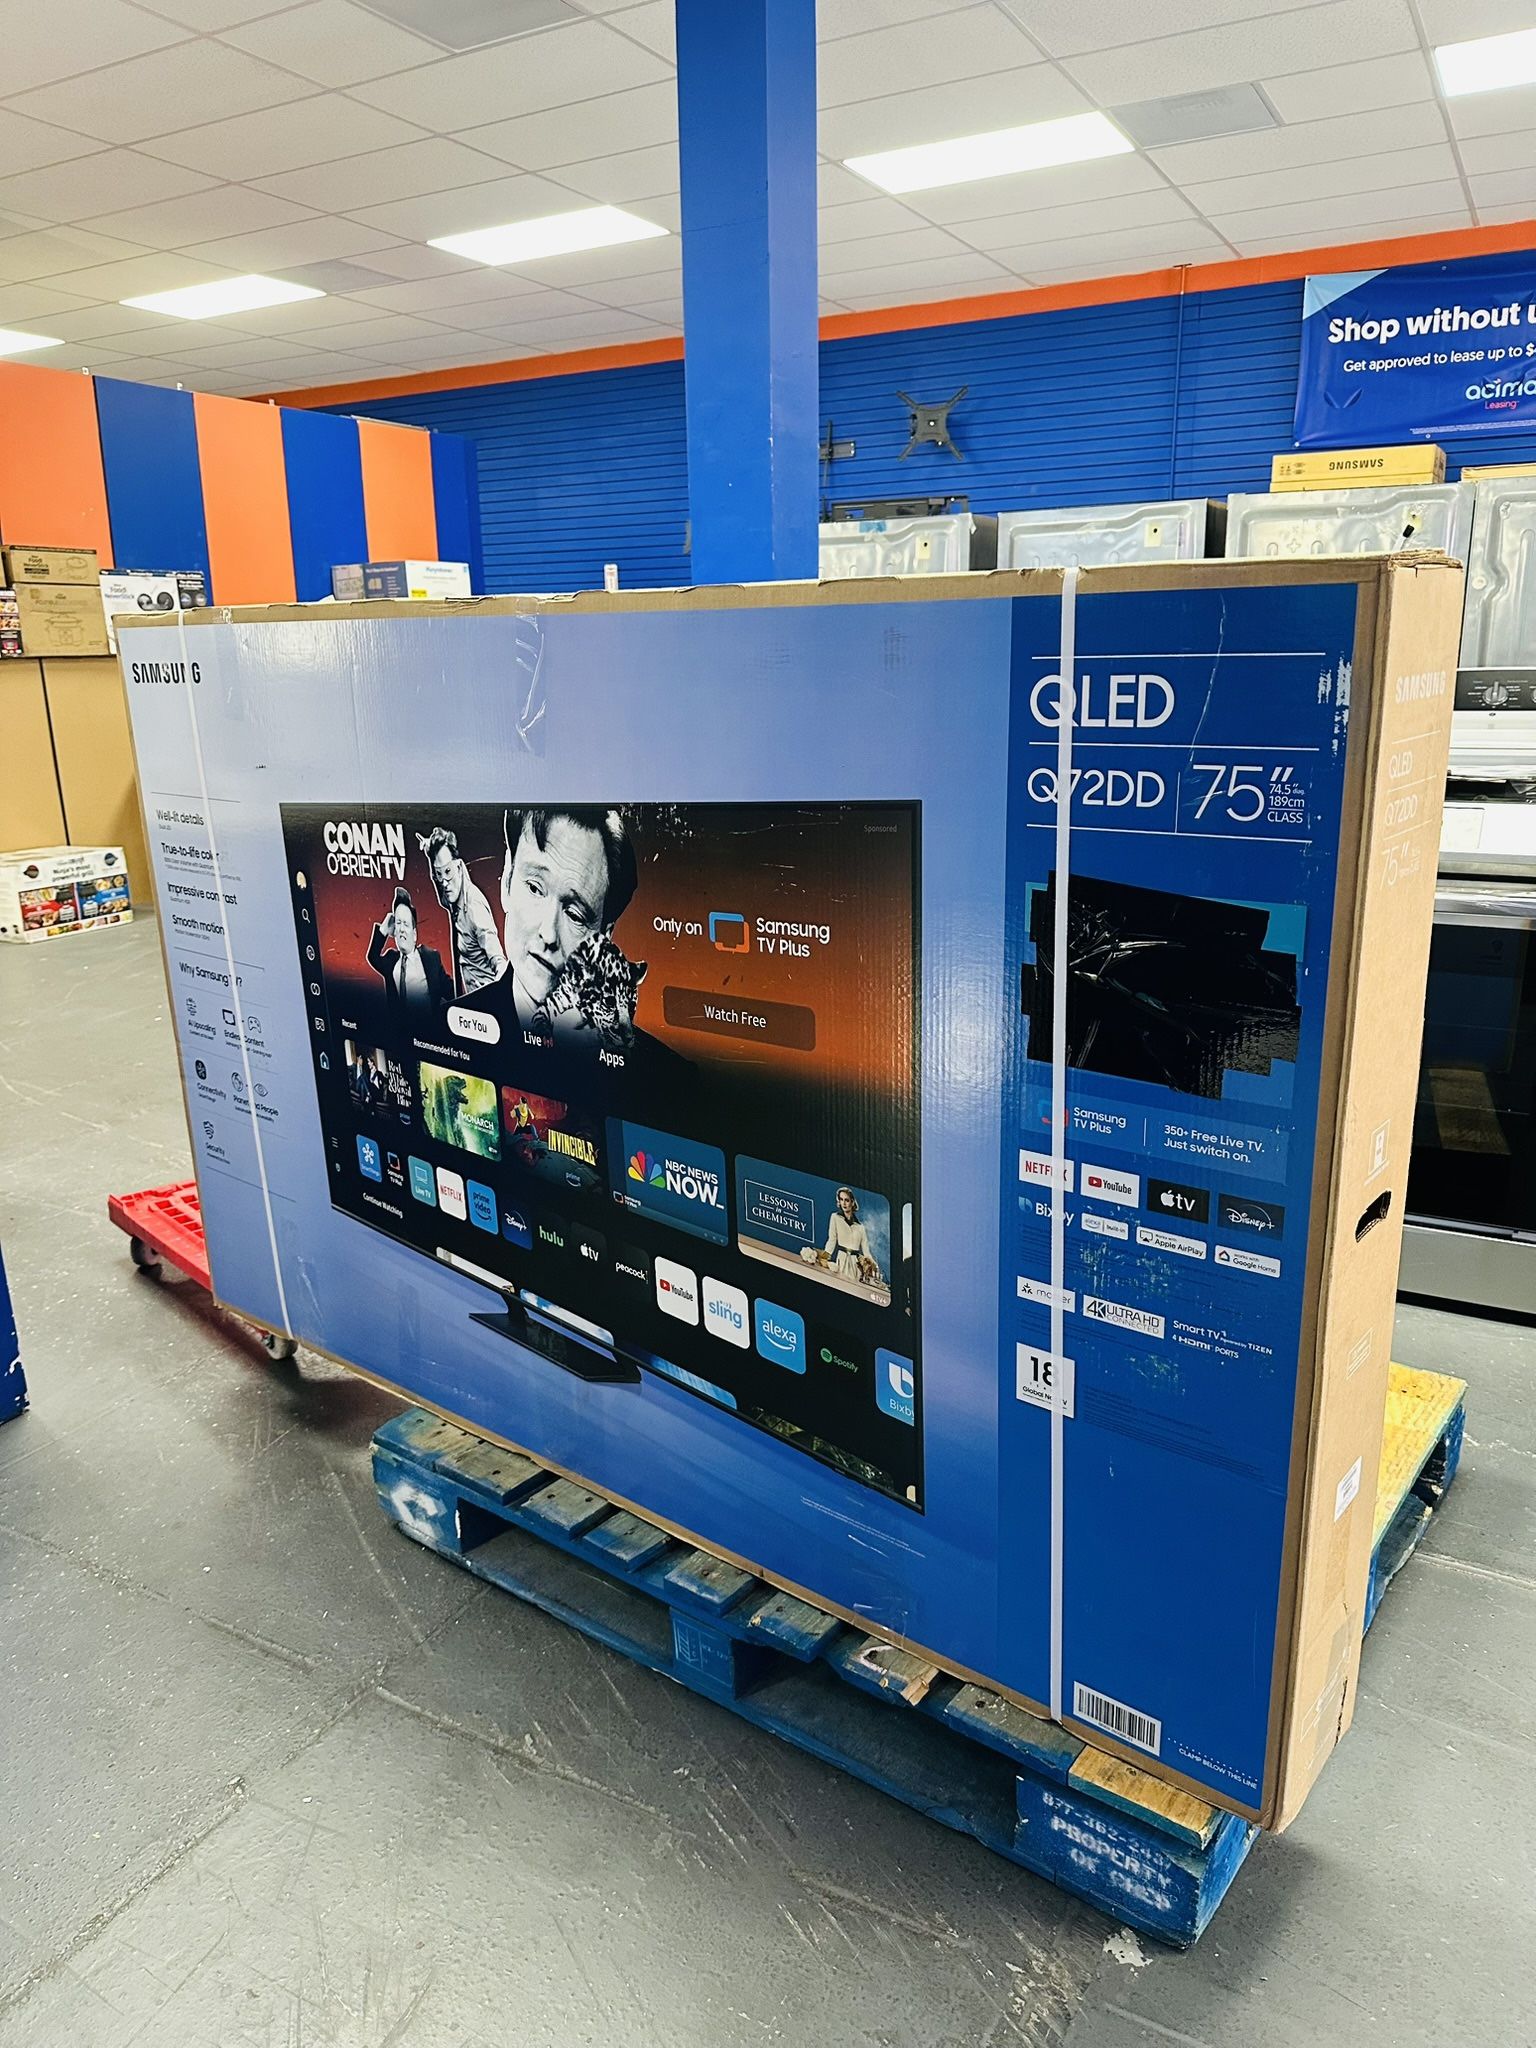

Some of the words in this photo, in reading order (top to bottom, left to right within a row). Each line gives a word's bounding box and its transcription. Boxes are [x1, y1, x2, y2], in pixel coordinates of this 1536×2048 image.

[1328, 317, 1400, 344] Shop
[1406, 303, 1521, 335] without
[1343, 359, 1367, 372] Get
[1369, 353, 1431, 372] approved
[1434, 353, 1448, 364] to
[1451, 350, 1484, 363] lease
[1488, 349, 1505, 361] up
[1508, 346, 1523, 357] to
[1485, 401, 1517, 409] Leasing
[1328, 458, 1384, 470] SAMSUNG
[1395, 671, 1446, 704] SAMSUNG
[1029, 675, 1174, 727] QLED
[1389, 751, 1413, 778] QLED
[1027, 768, 1165, 807] Q72DD
[1269, 796, 1304, 807] 189cm
[1385, 793, 1418, 827] Q72DD
[156, 809, 180, 823] Well-lit
[180, 813, 204, 826] details
[1267, 811, 1303, 823] CLASS
[863, 824, 897, 833] Sponsored
[323, 821, 405, 857] CONAN
[161, 842, 200, 857] True-to-life
[201, 851, 219, 861] colr
[167, 882, 204, 898] Impressive
[206, 891, 237, 905] conast
[172, 914, 199, 929] Smooth
[200, 921, 225, 935] motion
[653, 917, 683, 937] Only
[685, 921, 702, 936] on
[756, 917, 830, 945] Samsung
[757, 937, 775, 954] TV
[780, 939, 810, 957] Plus
[179, 961, 194, 978] Why
[196, 966, 229, 986] Samsung
[341, 1018, 357, 1029] Recent
[458, 1015, 472, 1030] For
[474, 1018, 488, 1034] You
[703, 1004, 738, 1024] Watch
[741, 1011, 767, 1028] Free
[523, 1030, 542, 1047] Live
[413, 1038, 450, 1055] Recommended
[450, 1048, 458, 1057] for
[459, 1049, 470, 1061] You
[599, 1048, 625, 1068] Apps
[197, 1082, 226, 1100] Connectivity
[1073, 1118, 1088, 1131] TV
[1090, 1121, 1112, 1134] Plus
[1074, 1107, 1127, 1128] Samsung
[548, 1128, 597, 1167] INVINCIBLE
[1164, 1125, 1188, 1138] 350+
[1191, 1130, 1217, 1144] Free
[1220, 1135, 1244, 1149] Live
[1247, 1140, 1265, 1153] TV.
[205, 1142, 225, 1157] Security
[1164, 1137, 1188, 1151] Just
[1190, 1142, 1230, 1160] switch
[1232, 1150, 1251, 1164] on.
[665, 1159, 687, 1174] NBC
[687, 1166, 718, 1185] NEWS
[440, 1185, 462, 1202] NETFLIX
[473, 1191, 490, 1205] prime
[759, 1192, 799, 1212] LESSONS
[1025, 1160, 1067, 1181] NETFX
[1103, 1180, 1132, 1194] YouTube
[1176, 1191, 1195, 1212] tv
[1226, 1207, 1275, 1231] Disney+
[474, 1201, 491, 1215] video
[1035, 1202, 1074, 1226] Bixy
[752, 1206, 807, 1233] CHEMISTRY
[539, 1225, 564, 1248] hulu
[588, 1247, 599, 1261] tv
[1154, 1238, 1176, 1249] Apple
[1177, 1244, 1203, 1257] AirPlay
[615, 1261, 646, 1281] peacock
[1233, 1257, 1256, 1269] Google
[1257, 1264, 1276, 1273] Home
[671, 1284, 694, 1302] YouTube
[1037, 1289, 1071, 1304] maer
[708, 1299, 743, 1329] sling
[1087, 1300, 1106, 1318] 4K
[1106, 1303, 1141, 1322] ULTRA
[1143, 1314, 1160, 1328] HD
[1106, 1313, 1159, 1334] CONNECTED
[762, 1319, 797, 1344] alexa
[1173, 1320, 1205, 1336] Smart
[1206, 1329, 1220, 1340] TV
[1247, 1342, 1272, 1355] TIZEN
[1214, 1345, 1239, 1359] PORTS
[833, 1355, 859, 1373] Spotify
[1022, 1385, 1044, 1398] Global
[1179, 1747, 1202, 1762] CLAMP
[1202, 1759, 1226, 1775] BELOW
[1227, 1770, 1242, 1783] THIS
[1242, 1777, 1257, 1790] LINE
